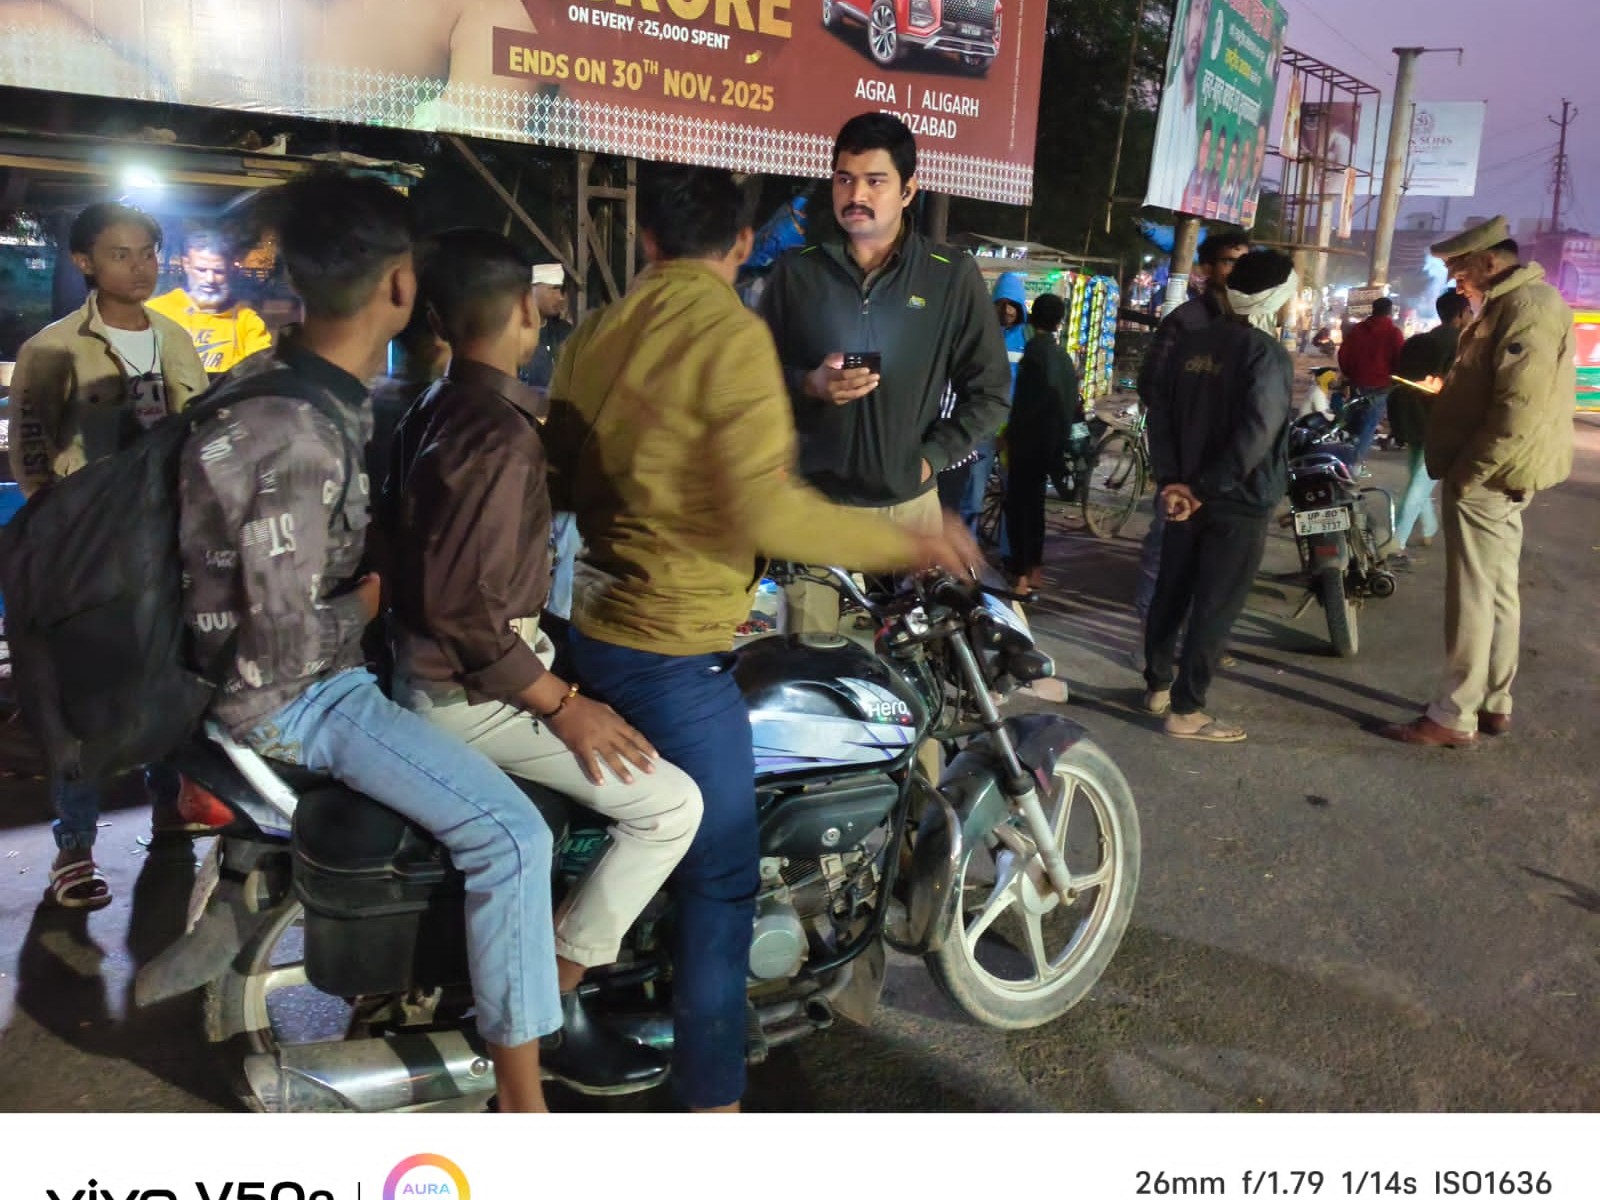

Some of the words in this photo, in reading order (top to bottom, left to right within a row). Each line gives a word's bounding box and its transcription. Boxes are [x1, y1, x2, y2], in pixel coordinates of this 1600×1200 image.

[568, 5, 589, 23] ON
[592, 10, 635, 32] EVERY
[637, 20, 689, 42] ₹25,000
[691, 29, 730, 50] SPENT
[509, 46, 569, 79] ENDS
[574, 57, 606, 85] ON
[663, 68, 716, 103] NOV.
[721, 78, 775, 112] 2025
[854, 77, 896, 104] AGRA
[921, 89, 980, 118] ALIGARH
[868, 701, 908, 718] Hero
